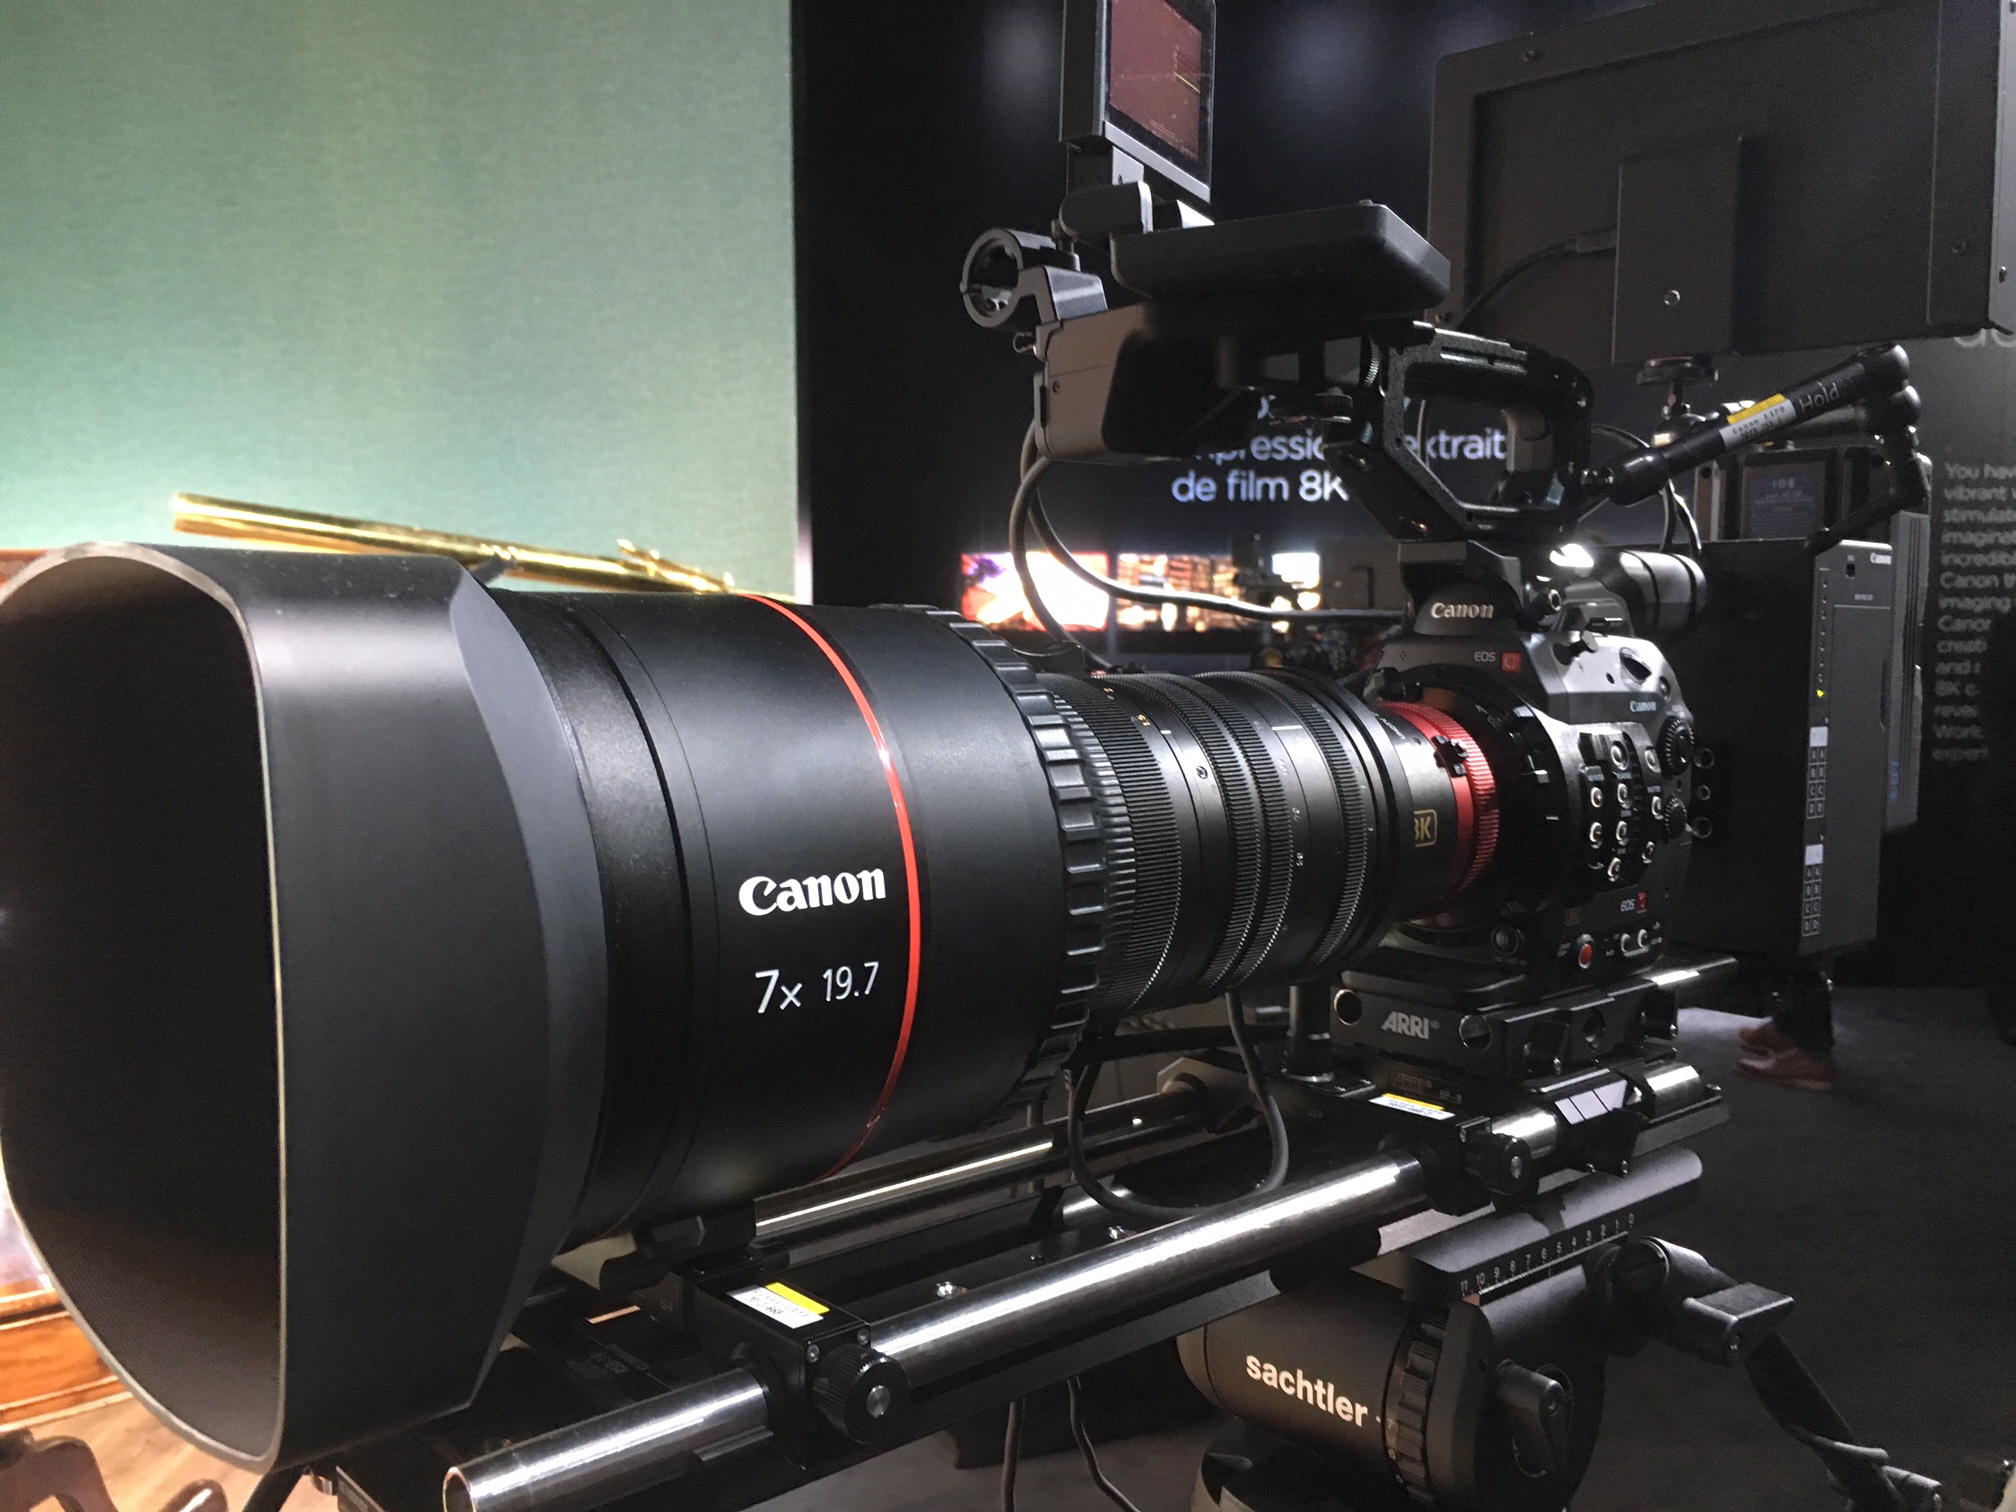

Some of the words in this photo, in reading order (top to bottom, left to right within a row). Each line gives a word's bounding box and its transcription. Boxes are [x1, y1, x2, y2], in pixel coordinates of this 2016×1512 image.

[1799, 382, 1840, 414] Hold
[1944, 463, 1980, 479] You
[1172, 470, 1217, 502] de
[1227, 468, 1290, 502] film
[1299, 469, 1349, 502] 8K
[1939, 571, 2000, 589] Canon
[1431, 602, 1494, 619] Canon
[1938, 595, 2012, 613] imaging
[1474, 651, 1497, 662] EOS
[738, 868, 886, 916] Canon
[755, 968, 803, 1014] 7x
[822, 960, 880, 1002] 19.7
[1381, 1011, 1430, 1040] ARRI
[1475, 1272, 1486, 1285] 10
[1245, 1354, 1369, 1428] sachtler
